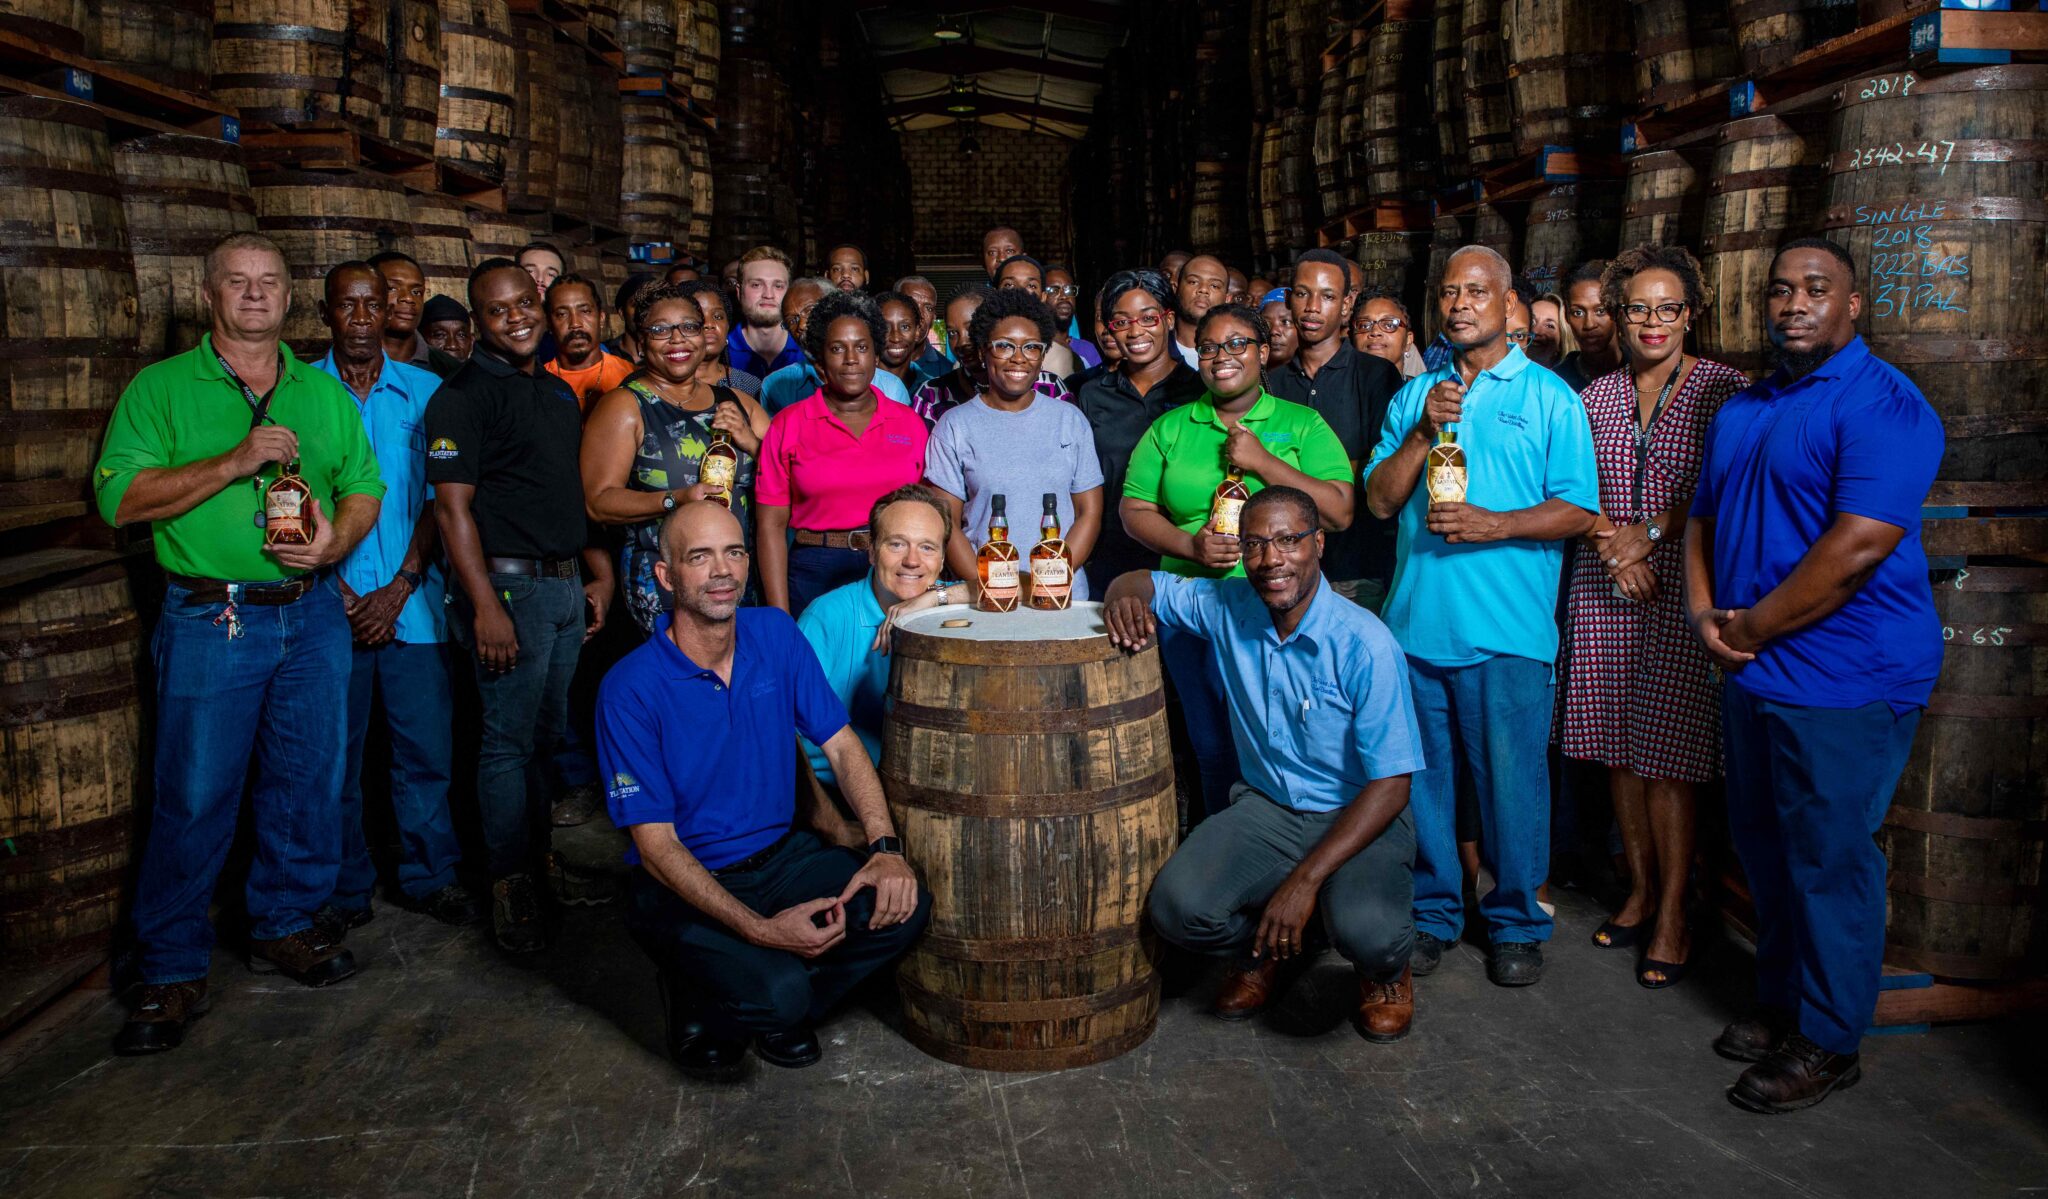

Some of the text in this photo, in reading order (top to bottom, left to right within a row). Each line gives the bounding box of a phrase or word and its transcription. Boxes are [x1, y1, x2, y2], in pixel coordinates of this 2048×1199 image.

[1861, 74, 1916, 99] 2018
[1850, 140, 1956, 176] 2542-47
[1855, 201, 1946, 224] SINGLE
[1872, 225, 1933, 248] 2018
[1873, 253, 1917, 280] 222
[1913, 284, 1967, 313] PAL
